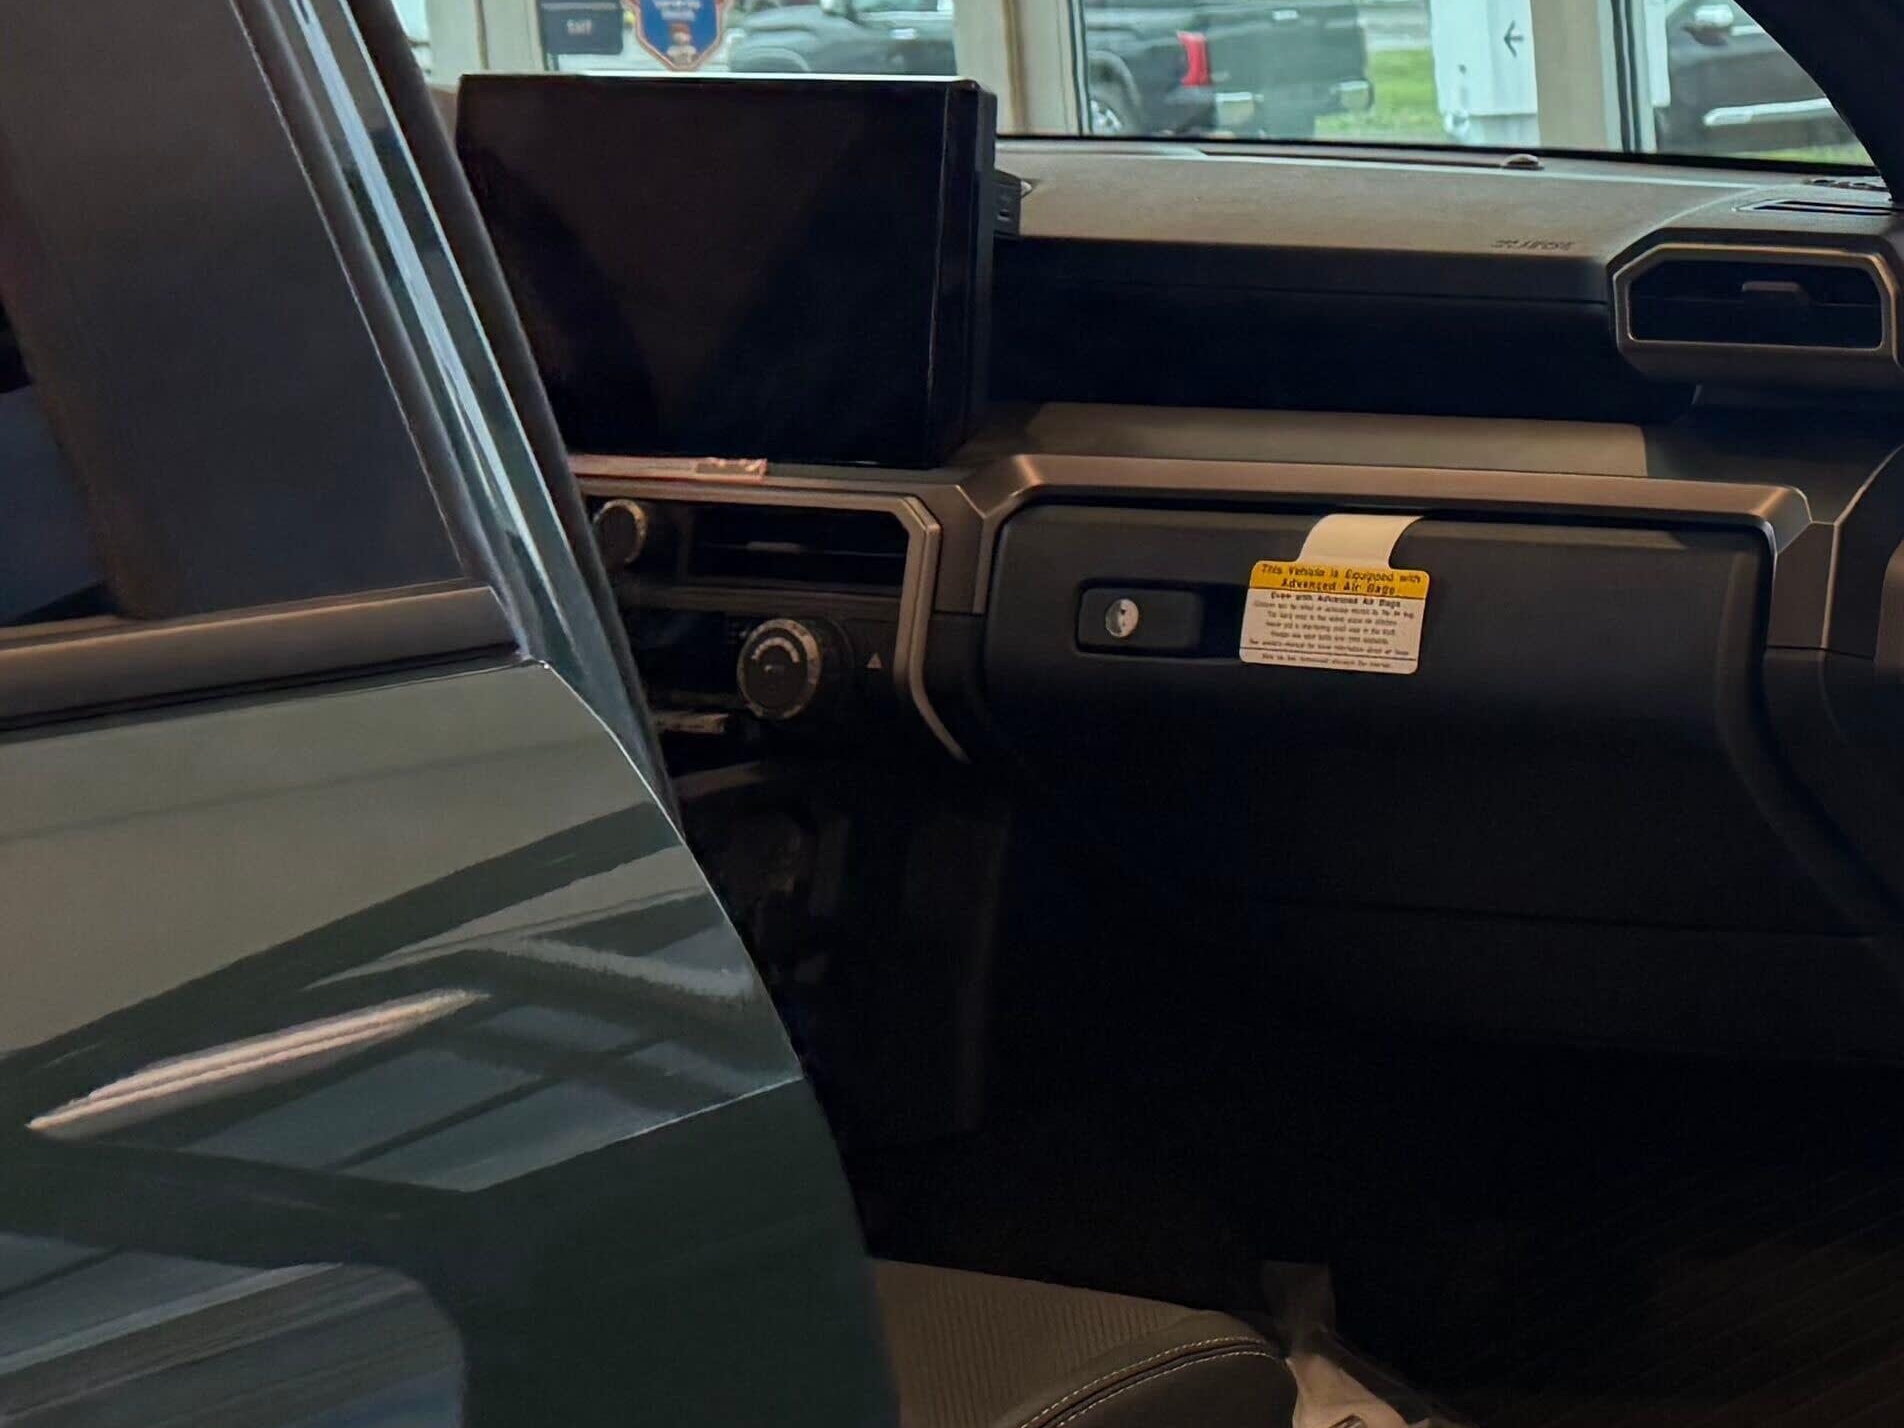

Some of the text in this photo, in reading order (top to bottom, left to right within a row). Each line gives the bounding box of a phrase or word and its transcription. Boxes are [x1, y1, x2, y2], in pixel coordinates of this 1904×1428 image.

[1261, 564, 1422, 583] This Vehicle is Equipped with
[1281, 578, 1396, 595] Advanced Air Bags
